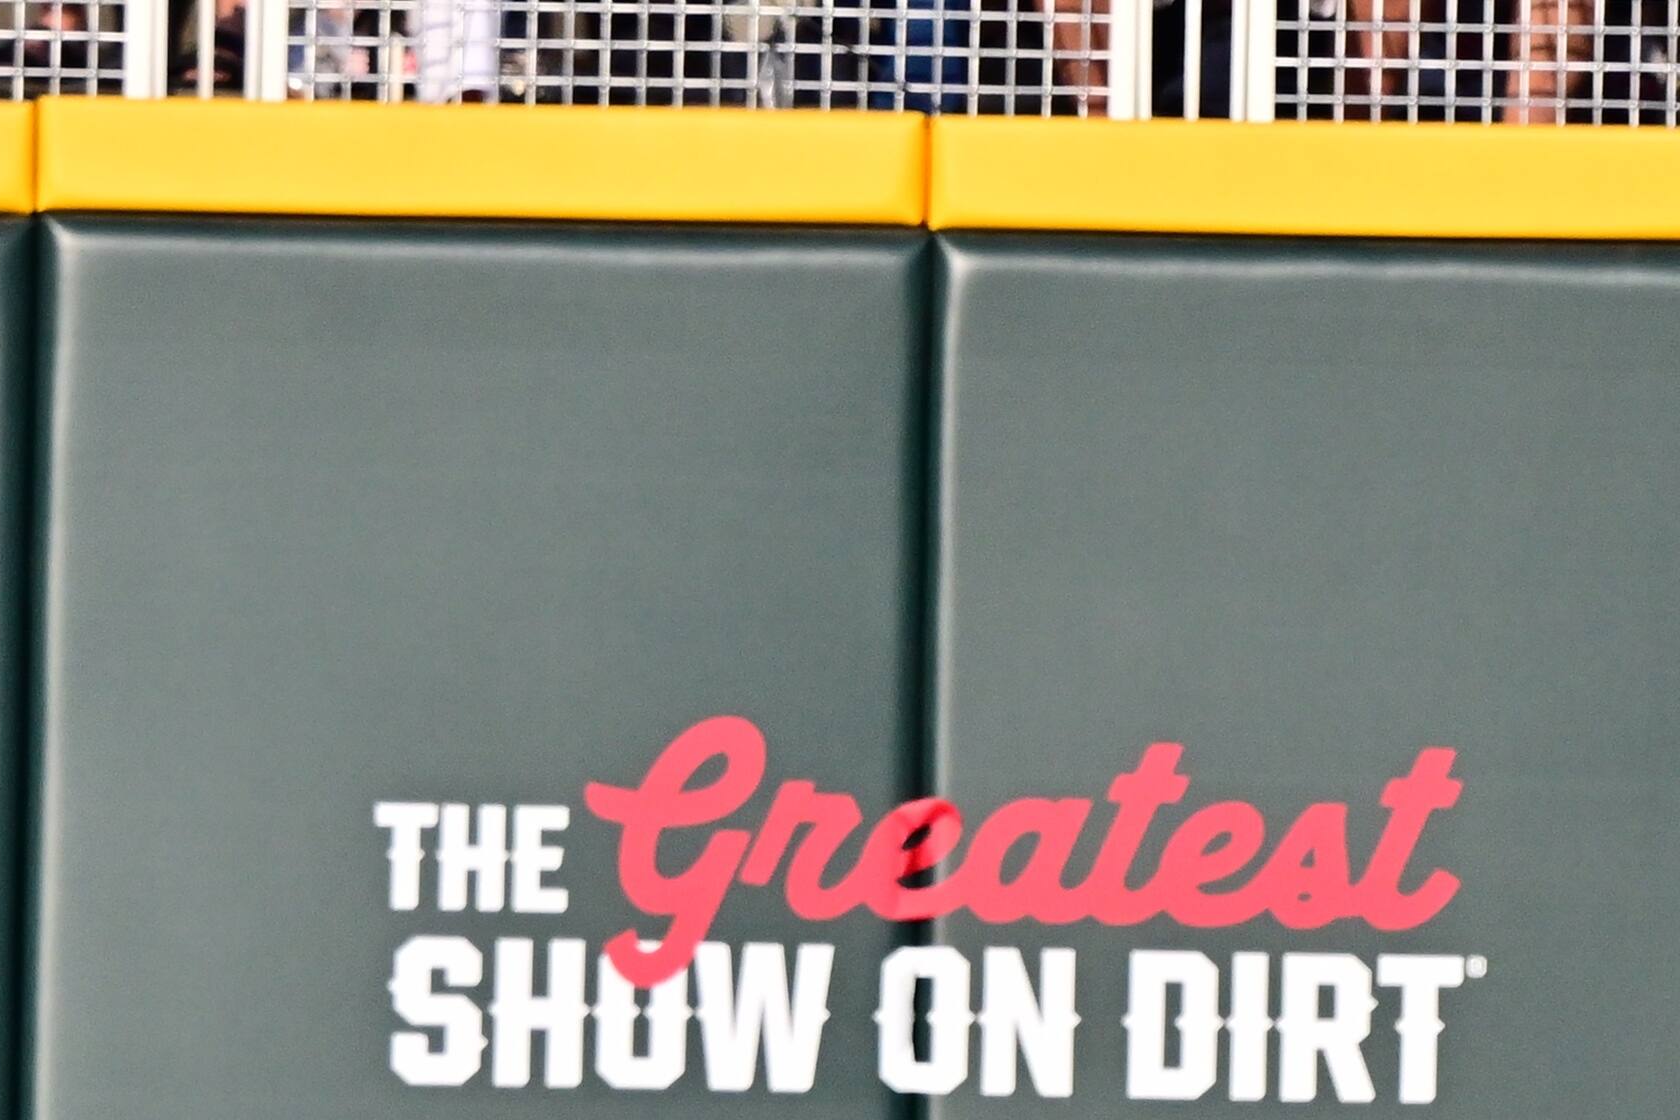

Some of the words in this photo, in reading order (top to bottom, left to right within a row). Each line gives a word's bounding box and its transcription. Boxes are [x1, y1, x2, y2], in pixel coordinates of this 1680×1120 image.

[374, 802, 570, 913] THE
[585, 716, 1461, 989] Greatest
[389, 936, 834, 1092] SHOW
[875, 946, 1081, 1099] ON
[1124, 950, 1465, 1103] DIRT
